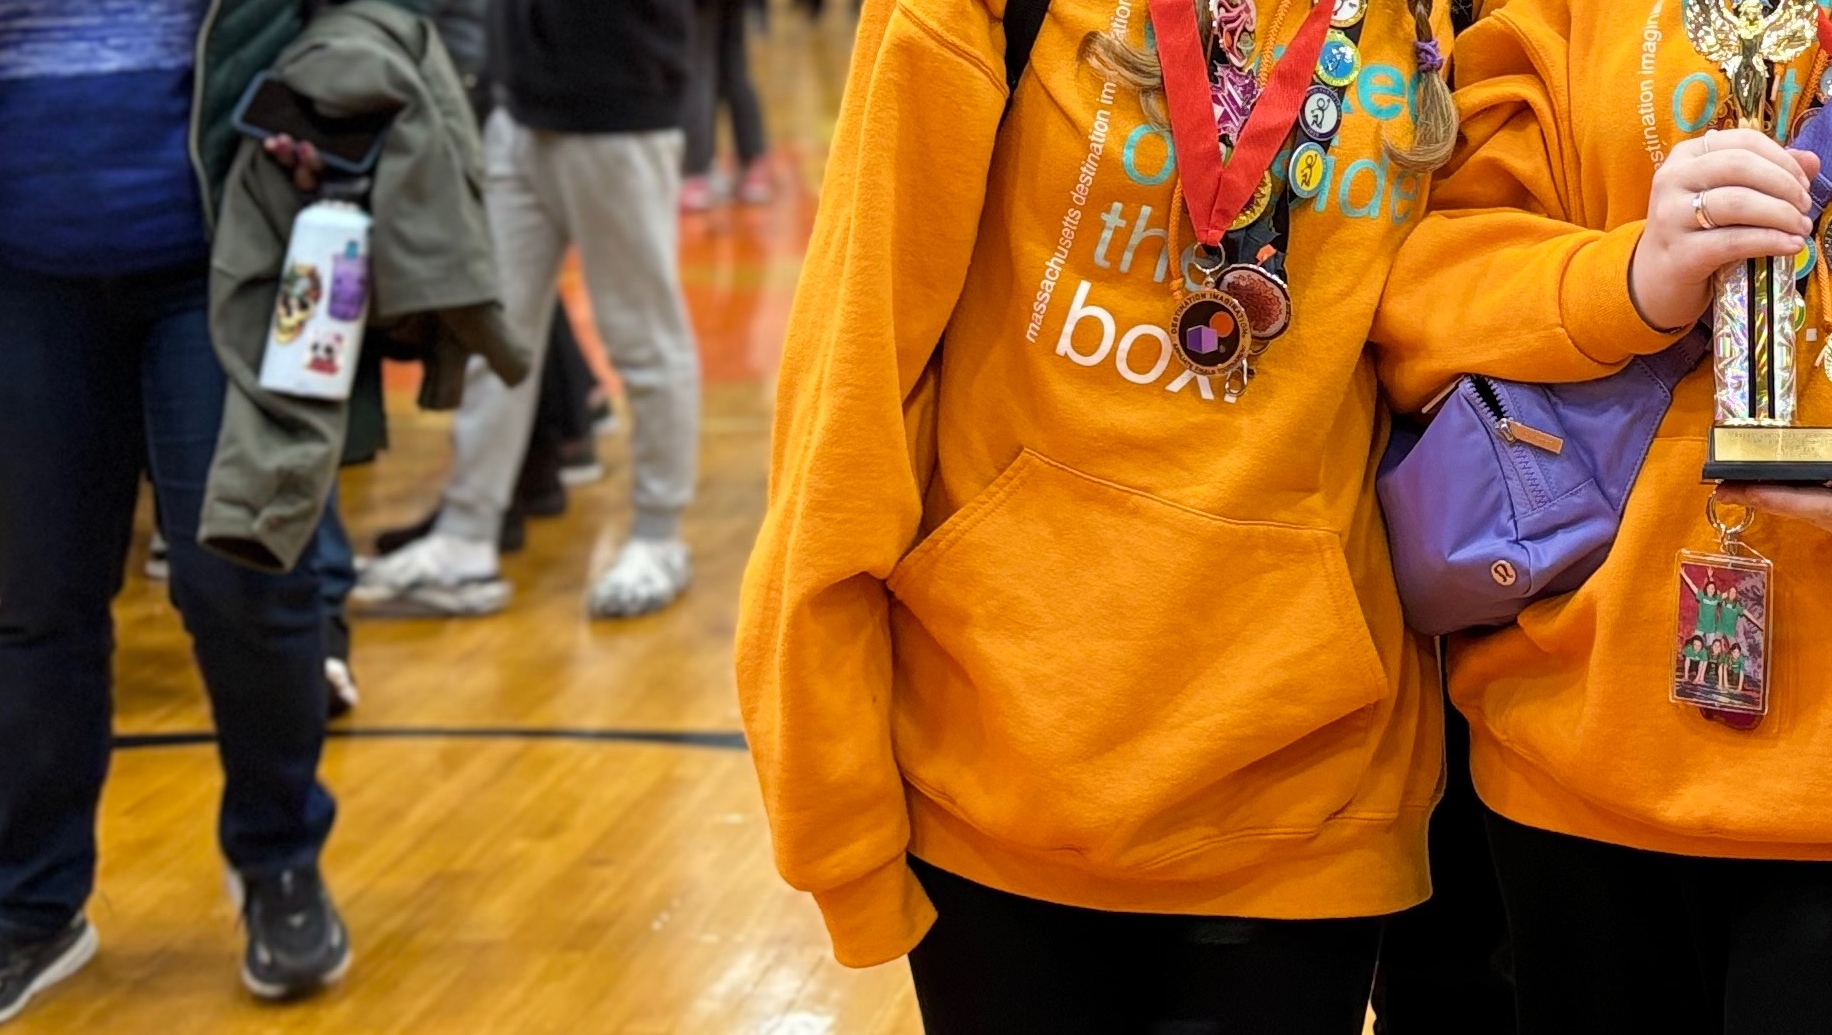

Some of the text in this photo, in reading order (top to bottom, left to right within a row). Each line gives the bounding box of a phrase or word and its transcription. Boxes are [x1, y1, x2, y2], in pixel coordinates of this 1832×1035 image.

[1637, 80, 1665, 171] stination
[1025, 207, 1083, 344] massachusetts
[1070, 112, 1110, 207] destination
